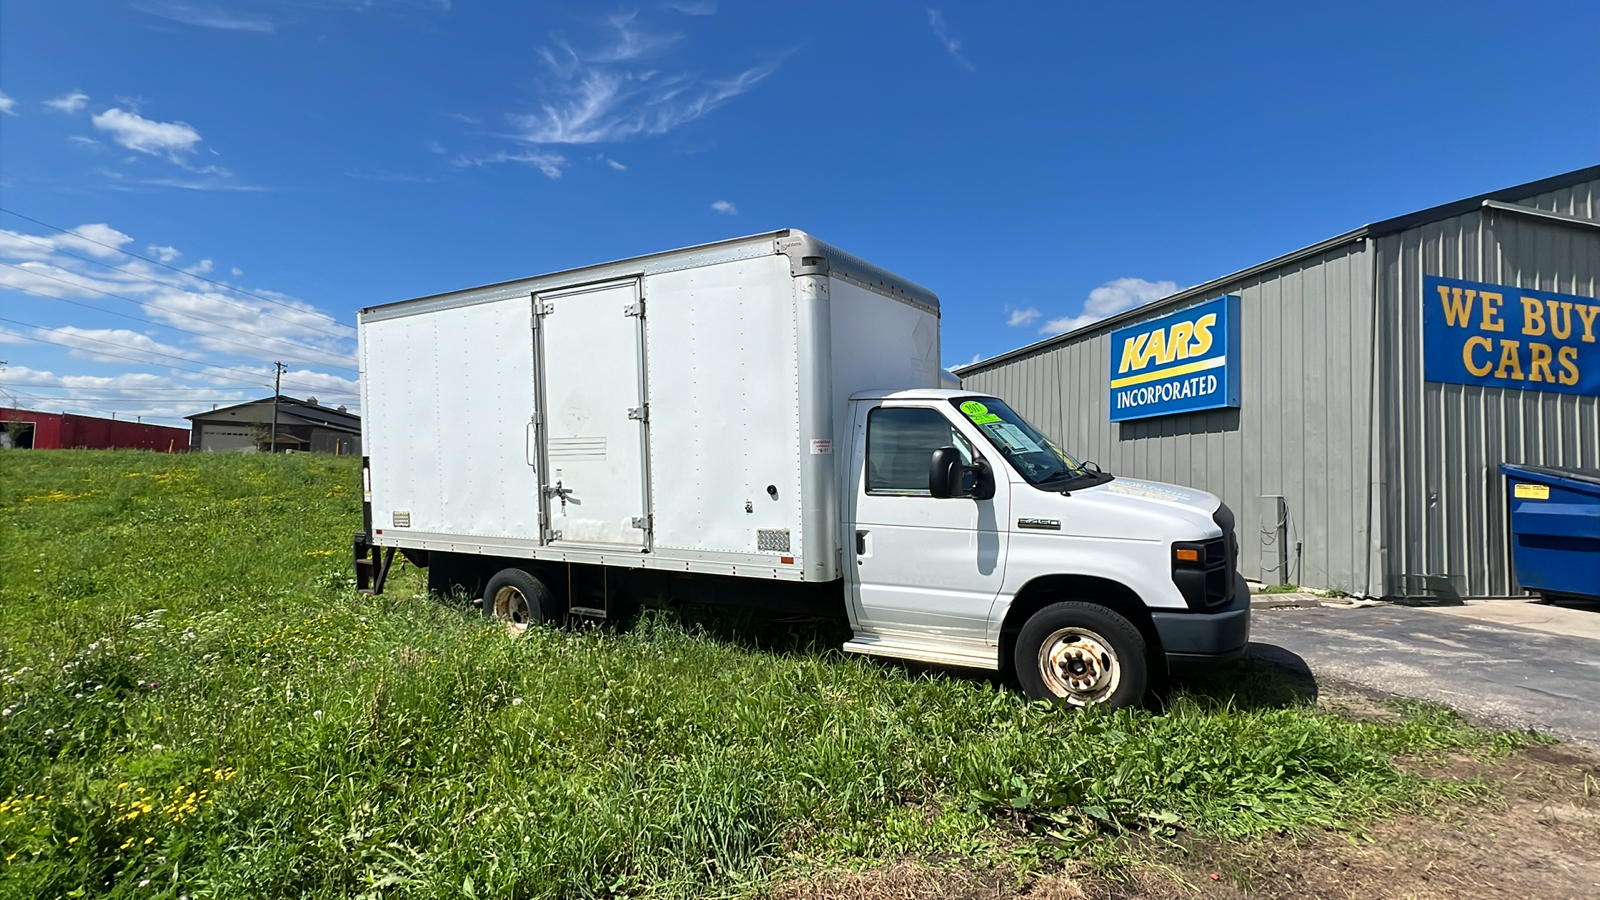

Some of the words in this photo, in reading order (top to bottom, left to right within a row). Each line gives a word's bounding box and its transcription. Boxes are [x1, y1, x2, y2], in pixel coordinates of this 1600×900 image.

[1437, 285, 1504, 332] WE
[1520, 296, 1600, 343] BUY
[1118, 313, 1217, 374] KARS
[1462, 335, 1580, 386] CARS
[1117, 374, 1217, 409] INCORPORATED
